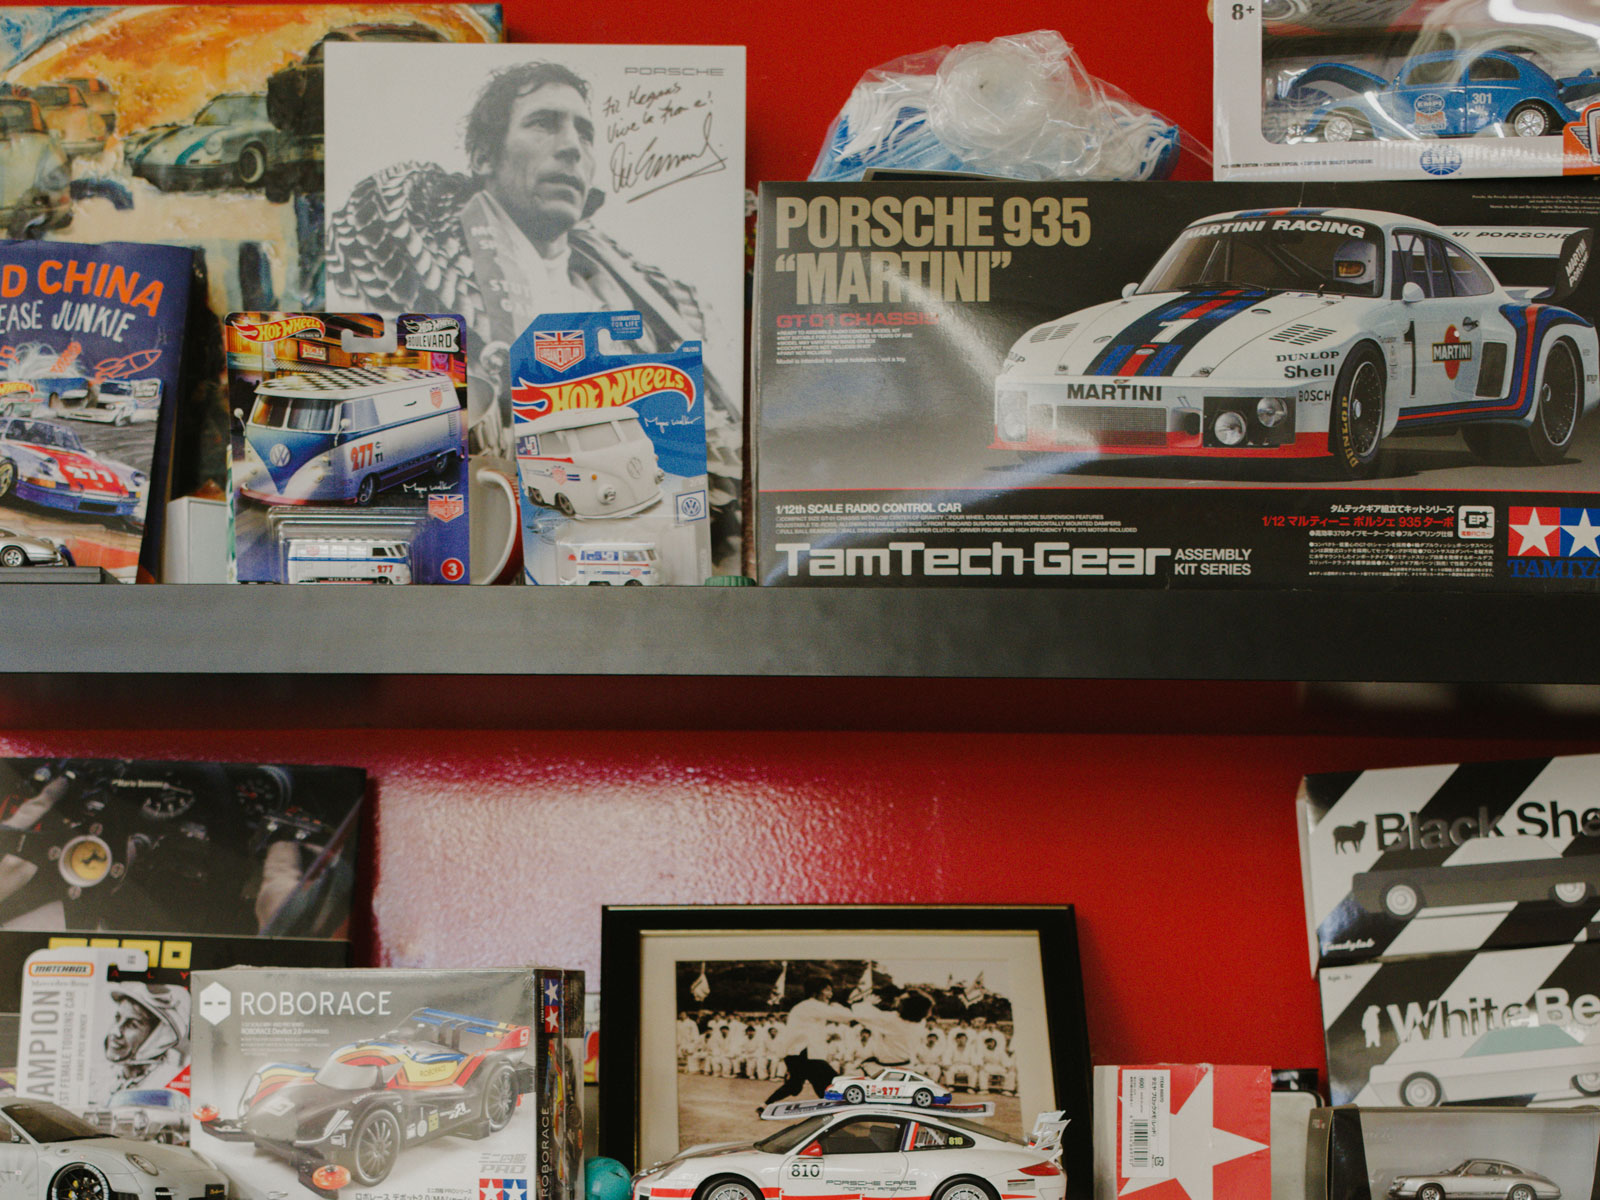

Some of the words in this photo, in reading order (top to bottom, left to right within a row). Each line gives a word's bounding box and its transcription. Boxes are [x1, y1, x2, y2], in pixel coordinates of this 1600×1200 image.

[1231, 3, 1255, 20] 8+
[624, 67, 725, 76] PORSCHE
[1472, 92, 1493, 105] 301
[776, 196, 995, 249] PORSCHE
[1002, 196, 1092, 247] 935
[1185, 220, 1265, 239] MARTINI
[1271, 219, 1367, 239] RACING
[1476, 231, 1571, 239] PORSCHE
[37, 259, 164, 317] CHINA
[52, 300, 136, 343] JUNKIE
[839, 311, 940, 327] CHASSIS
[1151, 318, 1200, 344] 1
[408, 333, 453, 349] BOULEVARD
[1275, 351, 1341, 363] DUNLOP
[1403, 320, 1416, 399] 1
[1433, 343, 1472, 360] MARTINI
[1283, 365, 1337, 379] Shell
[1066, 383, 1162, 401] MARTINI
[1298, 390, 1331, 402] BOSCH
[350, 442, 374, 472] 277
[807, 503, 844, 514] SCALE
[845, 503, 881, 514] RADIO
[882, 503, 936, 513] CONTROL
[937, 503, 962, 513] CAR
[1262, 516, 1286, 527] 1/12
[1287, 516, 1351, 528] マルティーニ
[1398, 517, 1422, 527] 935
[1423, 516, 1455, 528] ターボ
[1468, 515, 1486, 526] EP
[775, 541, 1171, 577] TamTech-Gear
[1174, 548, 1252, 562] ASSEMBLY
[377, 565, 394, 574] 277
[446, 563, 458, 576] 3
[1174, 563, 1198, 576] KIT
[1199, 563, 1252, 576] SERIES
[1374, 806, 1505, 851] Black
[34, 964, 89, 975] MATCHBOX
[240, 991, 393, 1016] ROBORACE
[1387, 997, 1531, 1043] White
[519, 1028, 530, 1046] 9
[882, 1086, 900, 1096] 277
[540, 1106, 551, 1197] ROBORACE
[791, 1164, 820, 1177] 810
[826, 1179, 882, 1187] PORSCHE
[885, 1179, 917, 1187] CARS
